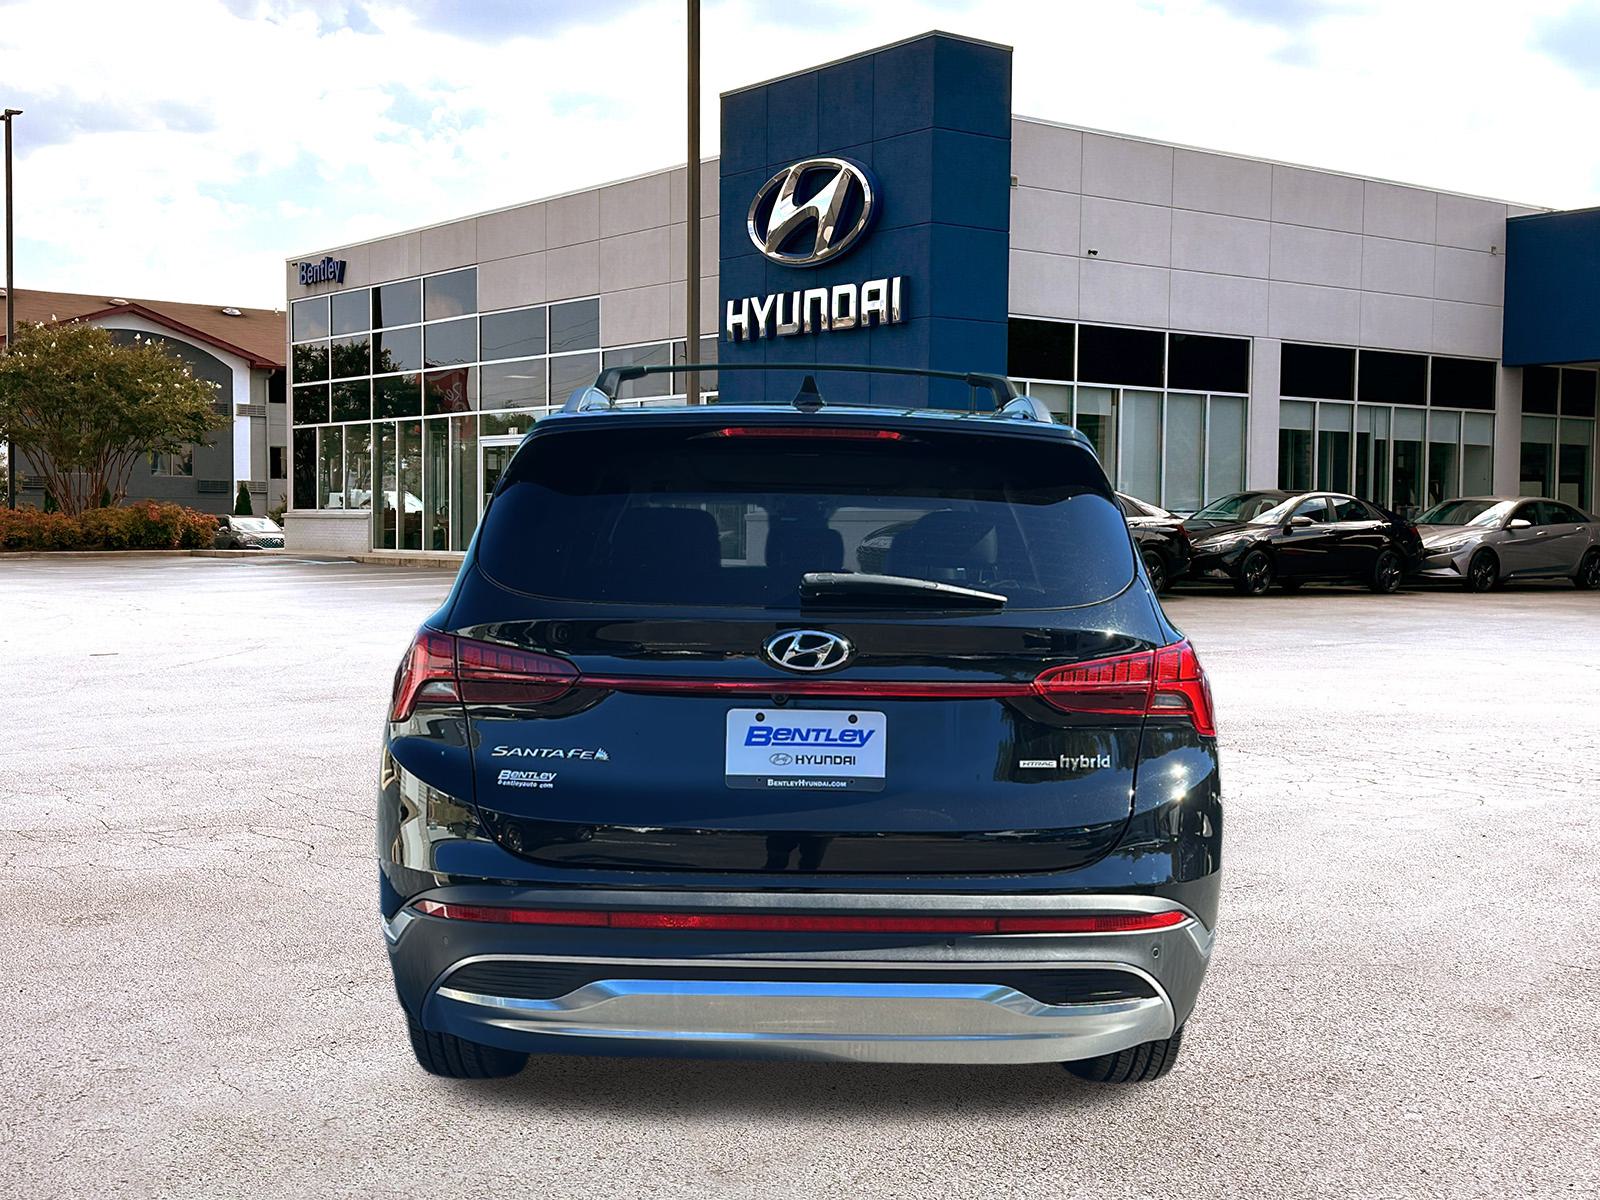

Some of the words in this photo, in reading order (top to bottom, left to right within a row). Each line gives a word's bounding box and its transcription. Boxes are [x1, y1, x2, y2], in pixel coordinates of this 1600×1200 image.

[299, 257, 343, 285] Bentley
[727, 277, 902, 342] HYUNDAI
[795, 755, 856, 766] HYUNDAI
[1060, 754, 1111, 771] hybrid
